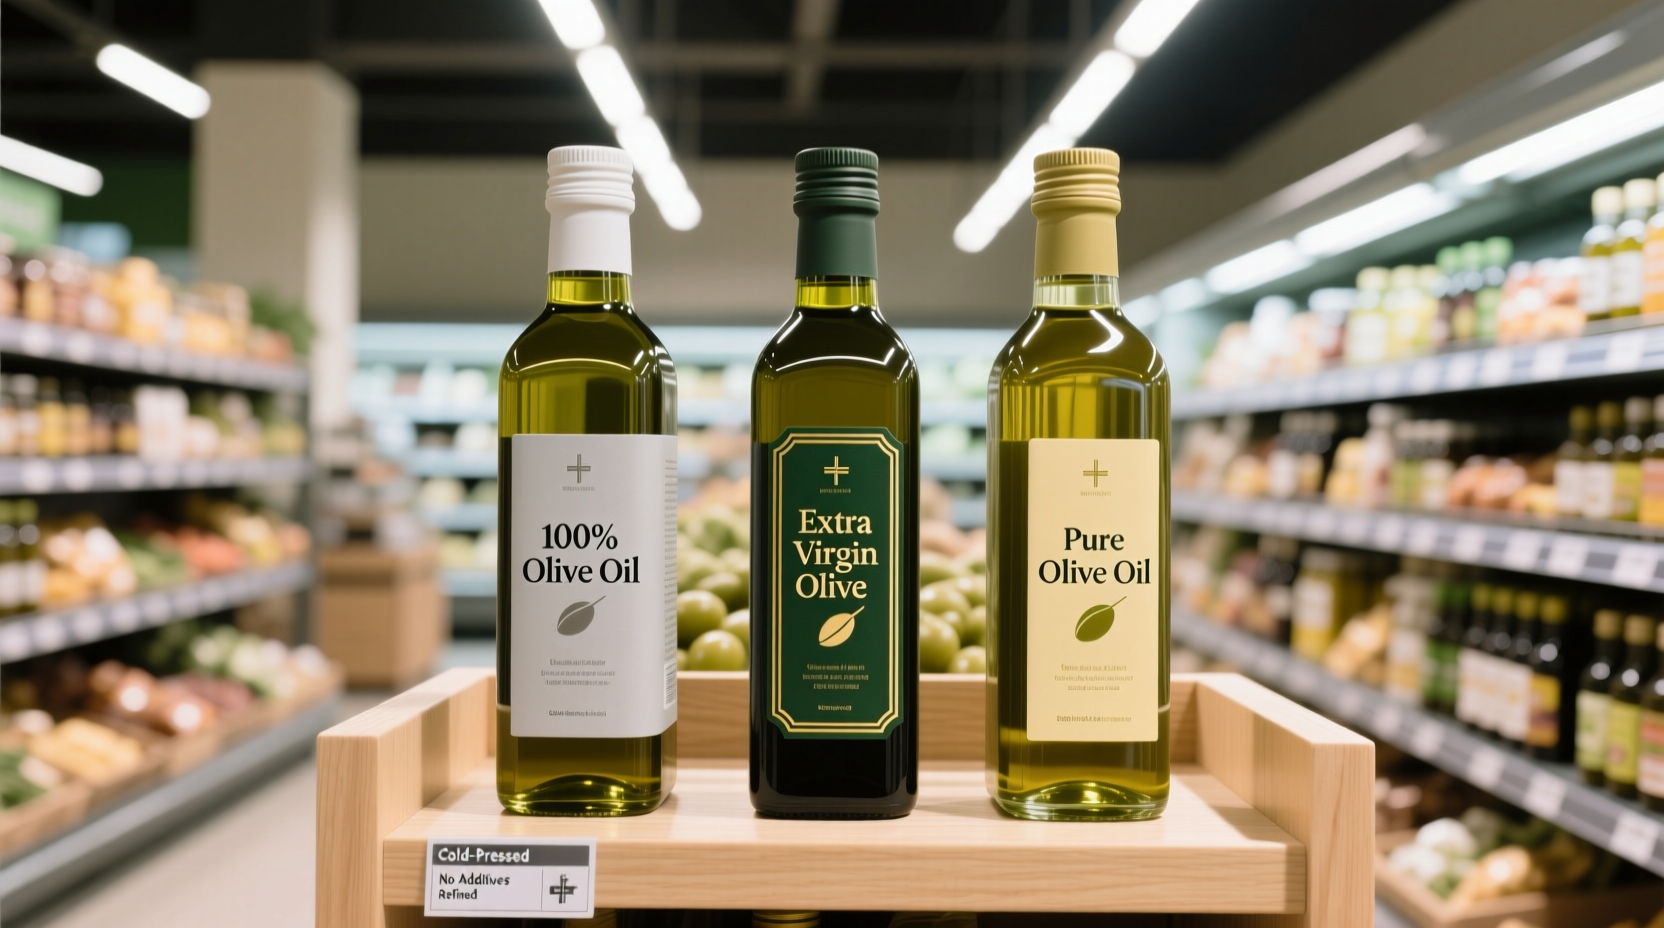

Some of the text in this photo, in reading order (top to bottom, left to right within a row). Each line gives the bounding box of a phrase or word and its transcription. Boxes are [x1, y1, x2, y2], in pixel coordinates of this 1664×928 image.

[798, 508, 872, 534] Extra
[541, 523, 618, 550] 100%
[1064, 527, 1125, 551] Pure
[522, 556, 640, 583] Olive Oil
[792, 540, 878, 573] Virgin
[1038, 558, 1151, 584] Olive Oil
[795, 573, 867, 599] Olive
[439, 873, 455, 885] No
